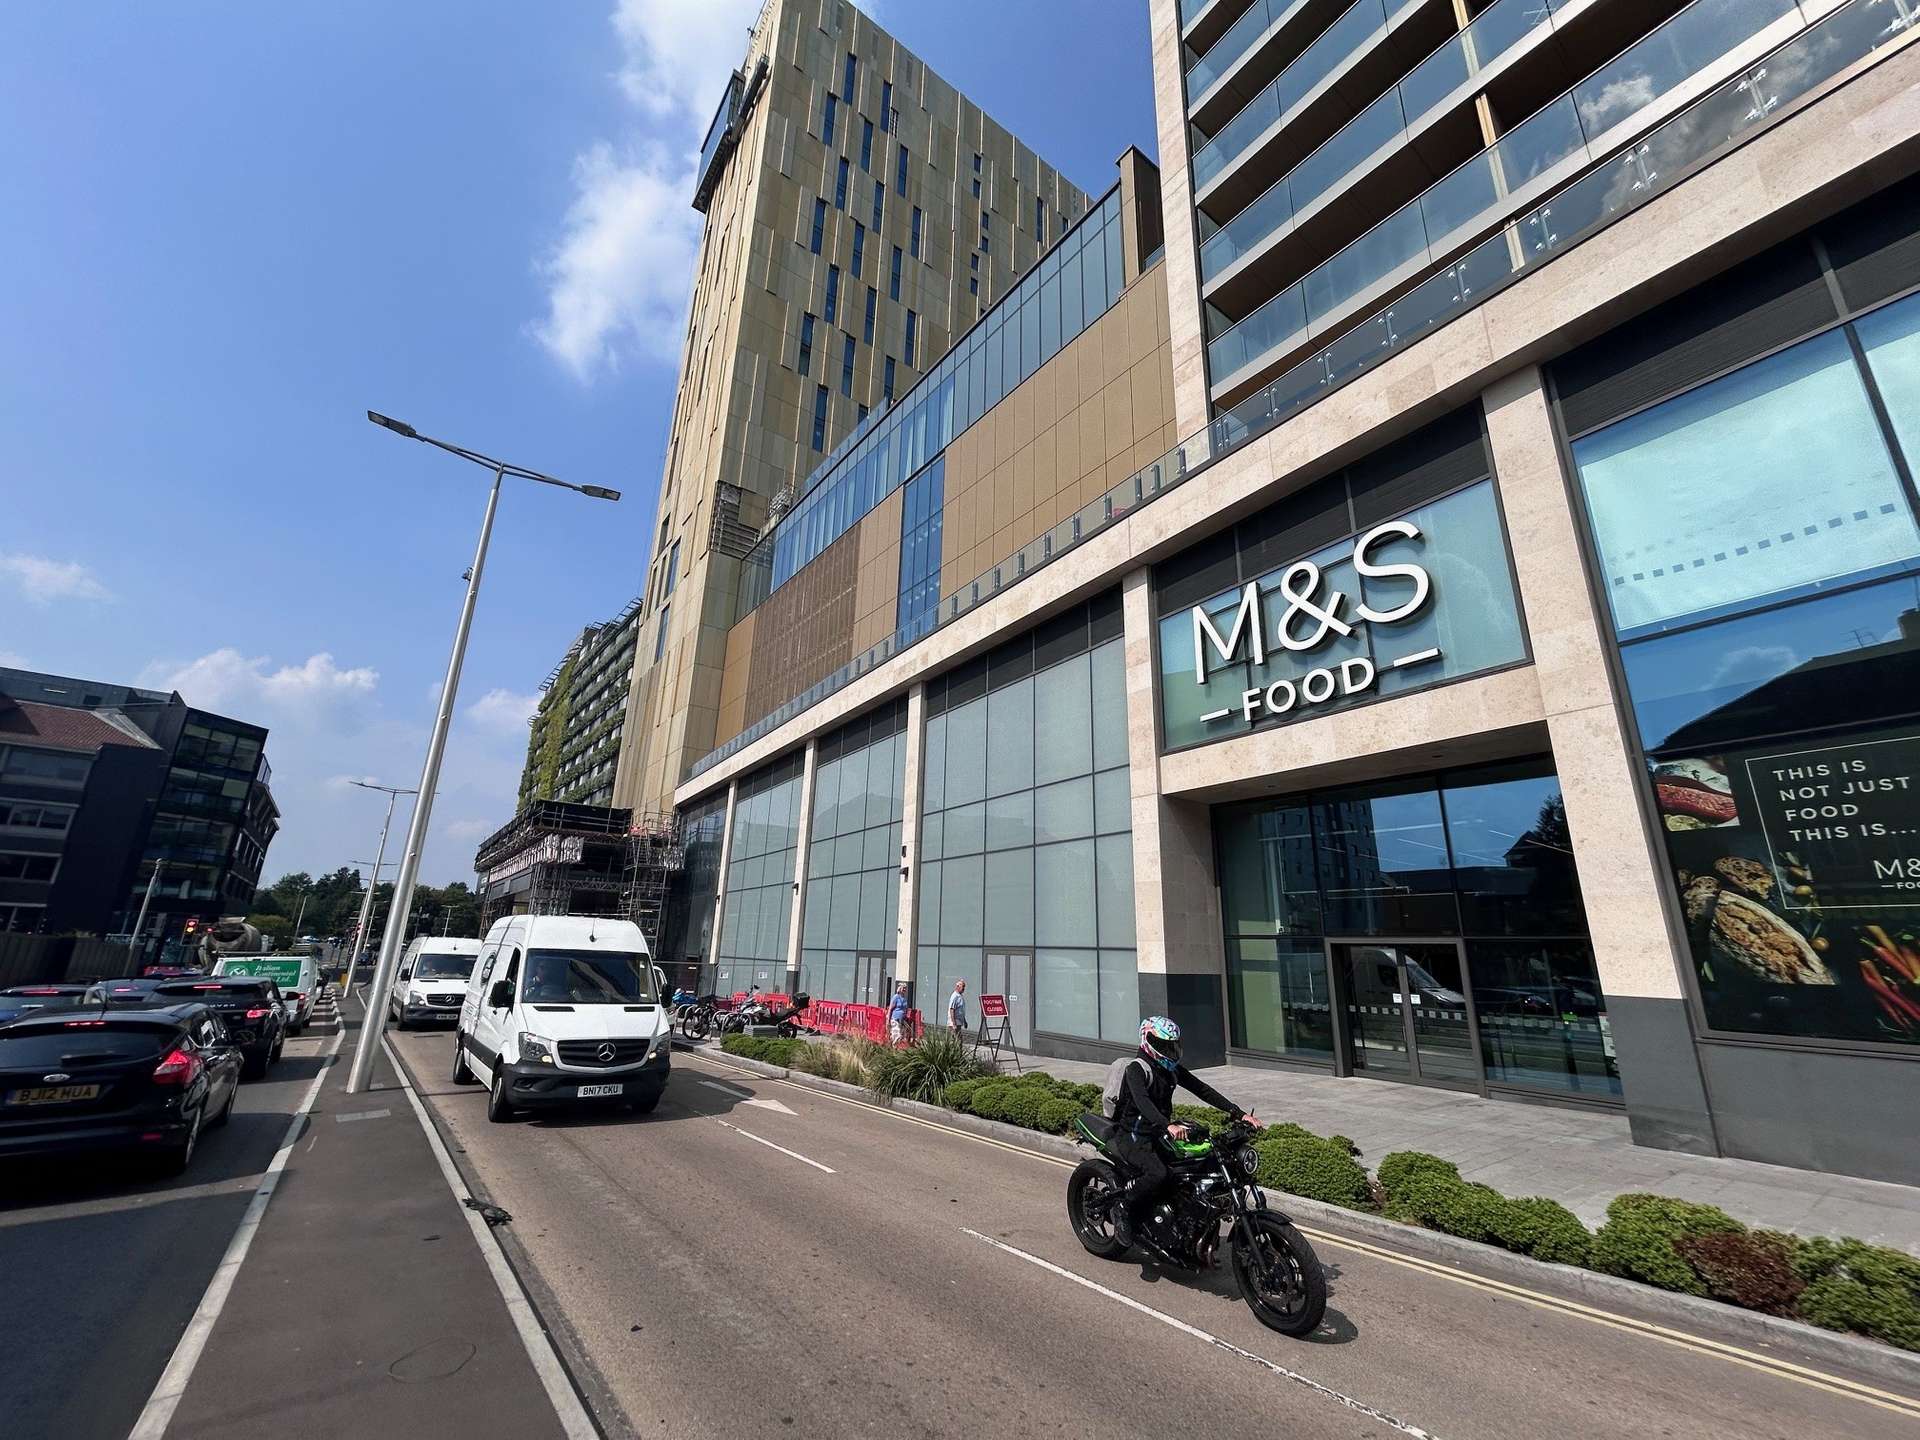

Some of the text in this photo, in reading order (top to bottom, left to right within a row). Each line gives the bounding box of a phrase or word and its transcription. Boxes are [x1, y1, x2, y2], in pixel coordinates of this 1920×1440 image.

[1192, 520, 1430, 684] M&S
[1241, 656, 1377, 722] FOOD
[1772, 759, 1867, 782] THIS IS
[1779, 776, 1910, 801] NOT JUST
[1785, 803, 1859, 822] FOOD
[1789, 823, 1917, 842] THIS IS...
